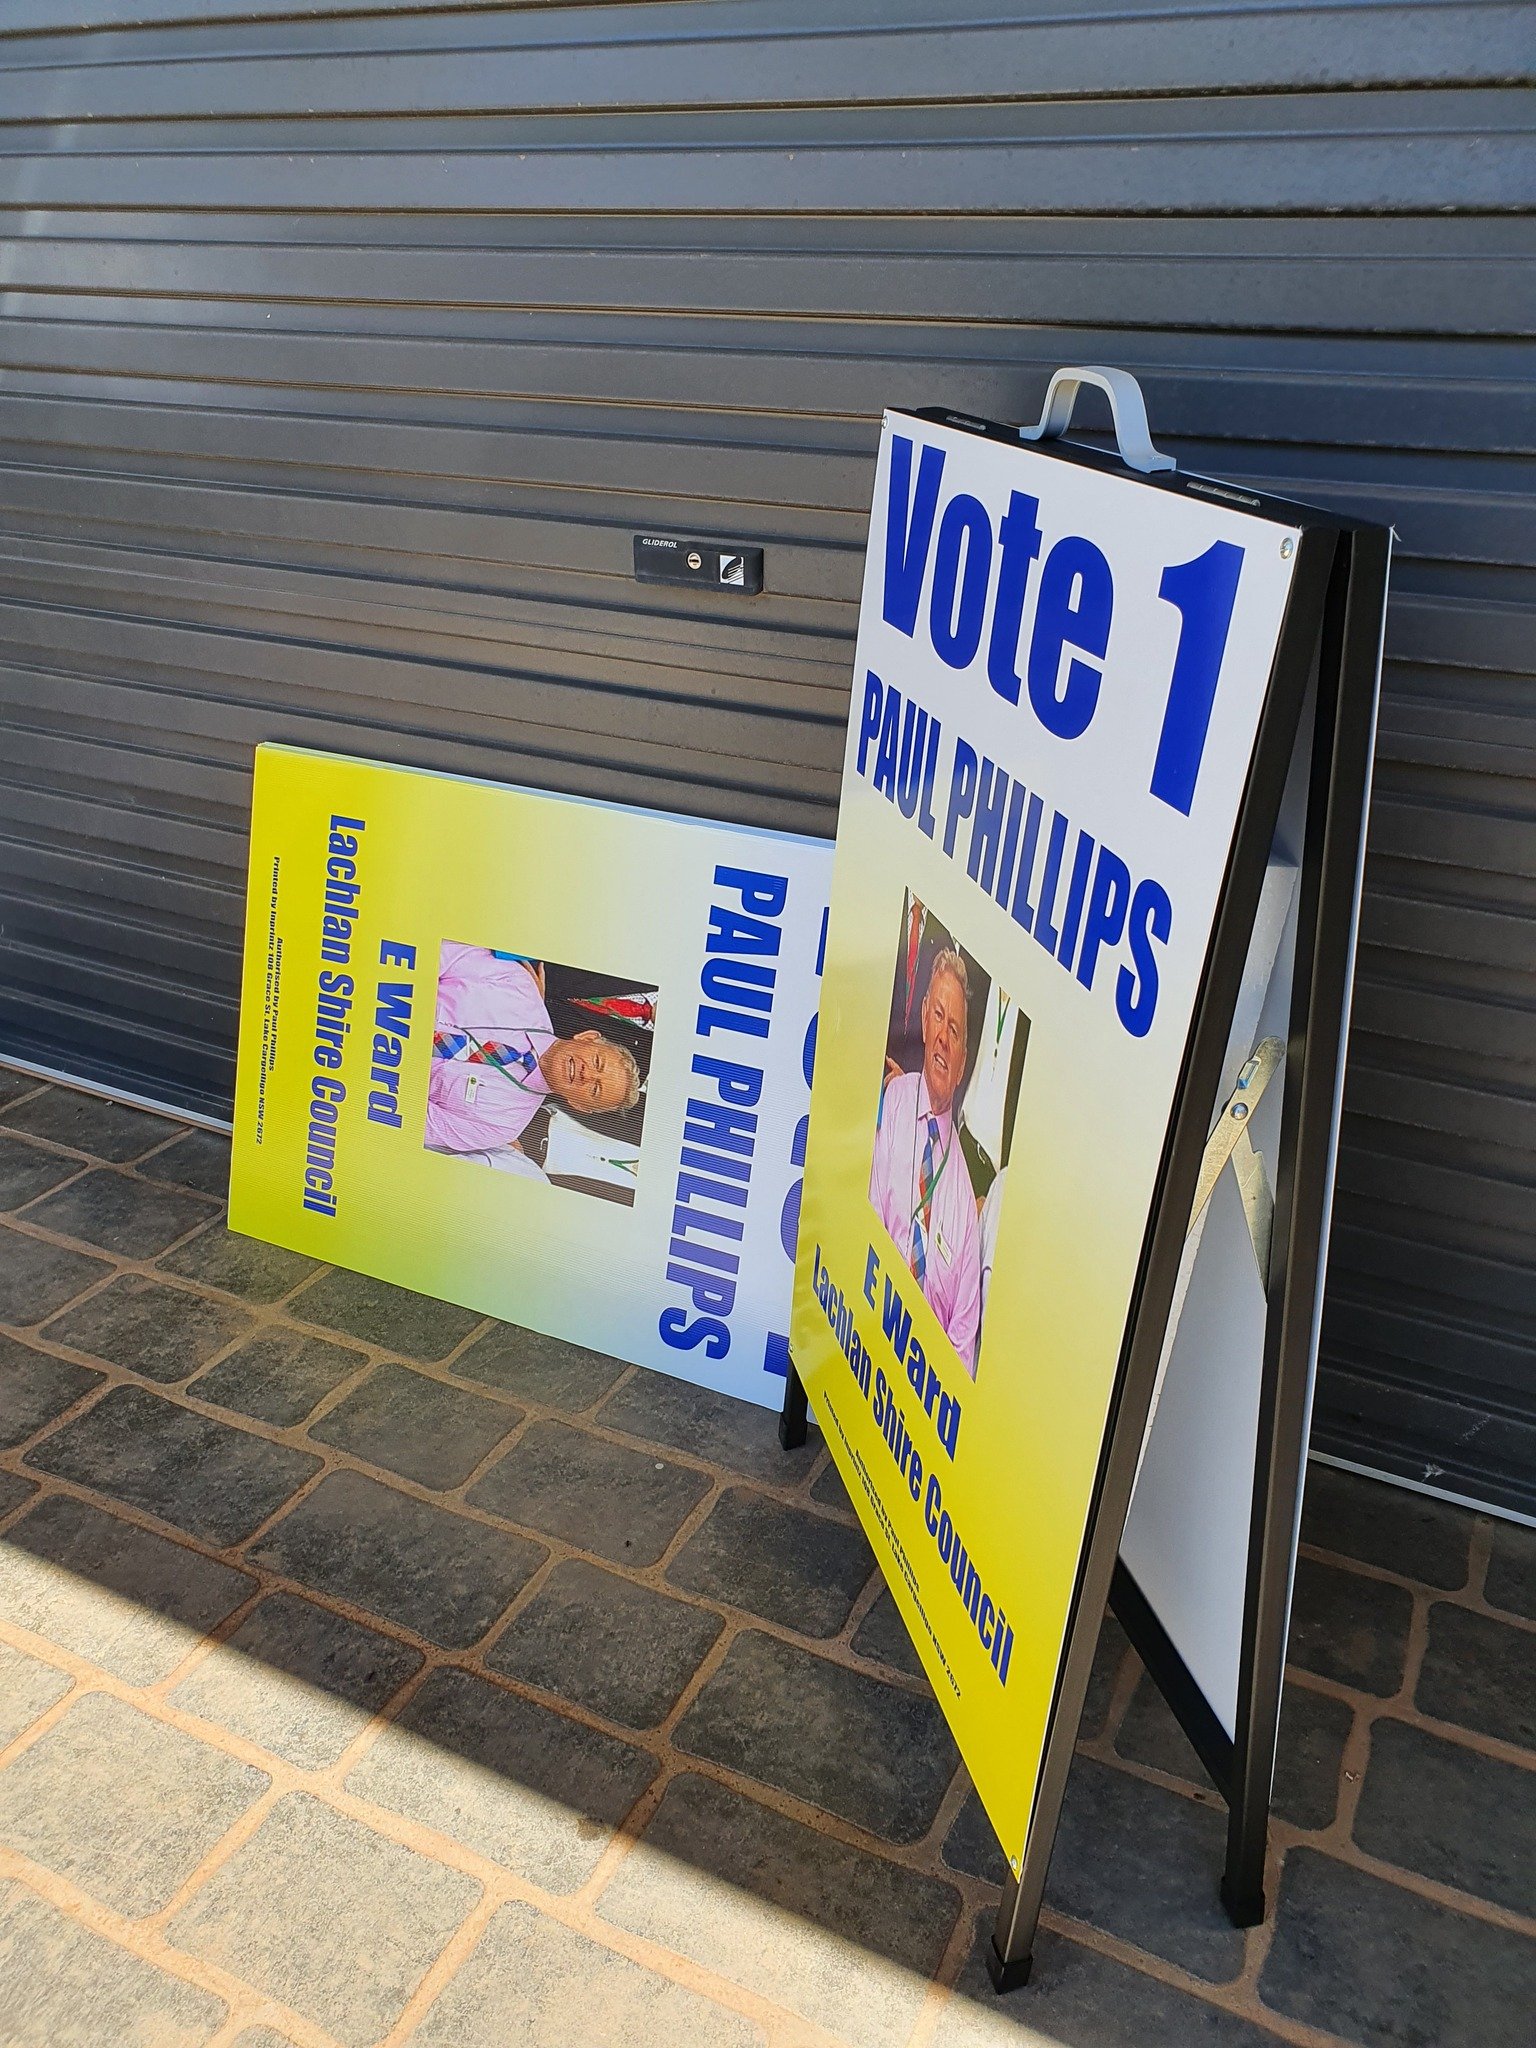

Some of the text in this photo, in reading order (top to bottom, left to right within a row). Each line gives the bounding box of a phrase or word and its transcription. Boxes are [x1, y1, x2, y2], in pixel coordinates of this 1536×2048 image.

[642, 538, 678, 549] GLIDEROL
[882, 434, 1245, 818] Vote 1
[272, 856, 280, 894] Printed
[857, 669, 1172, 1038] PAUL PHILLIPS
[271, 896, 278, 909] by
[262, 1018, 270, 1042] Lake
[265, 972, 273, 1002] Grace
[269, 937, 283, 1071] Authorised by Paul Phillips
[303, 814, 365, 1217] Lachlan Shire Council
[260, 1043, 268, 1095] Cargelligo
[367, 939, 416, 1129] E Ward
[256, 1121, 264, 1145] 2672
[257, 1097, 265, 1120] NSW
[658, 865, 789, 1360] PAUL PHILLIPS
[863, 1243, 961, 1462] E Ward
[813, 1243, 1014, 1687] Lachlan Shire Council
